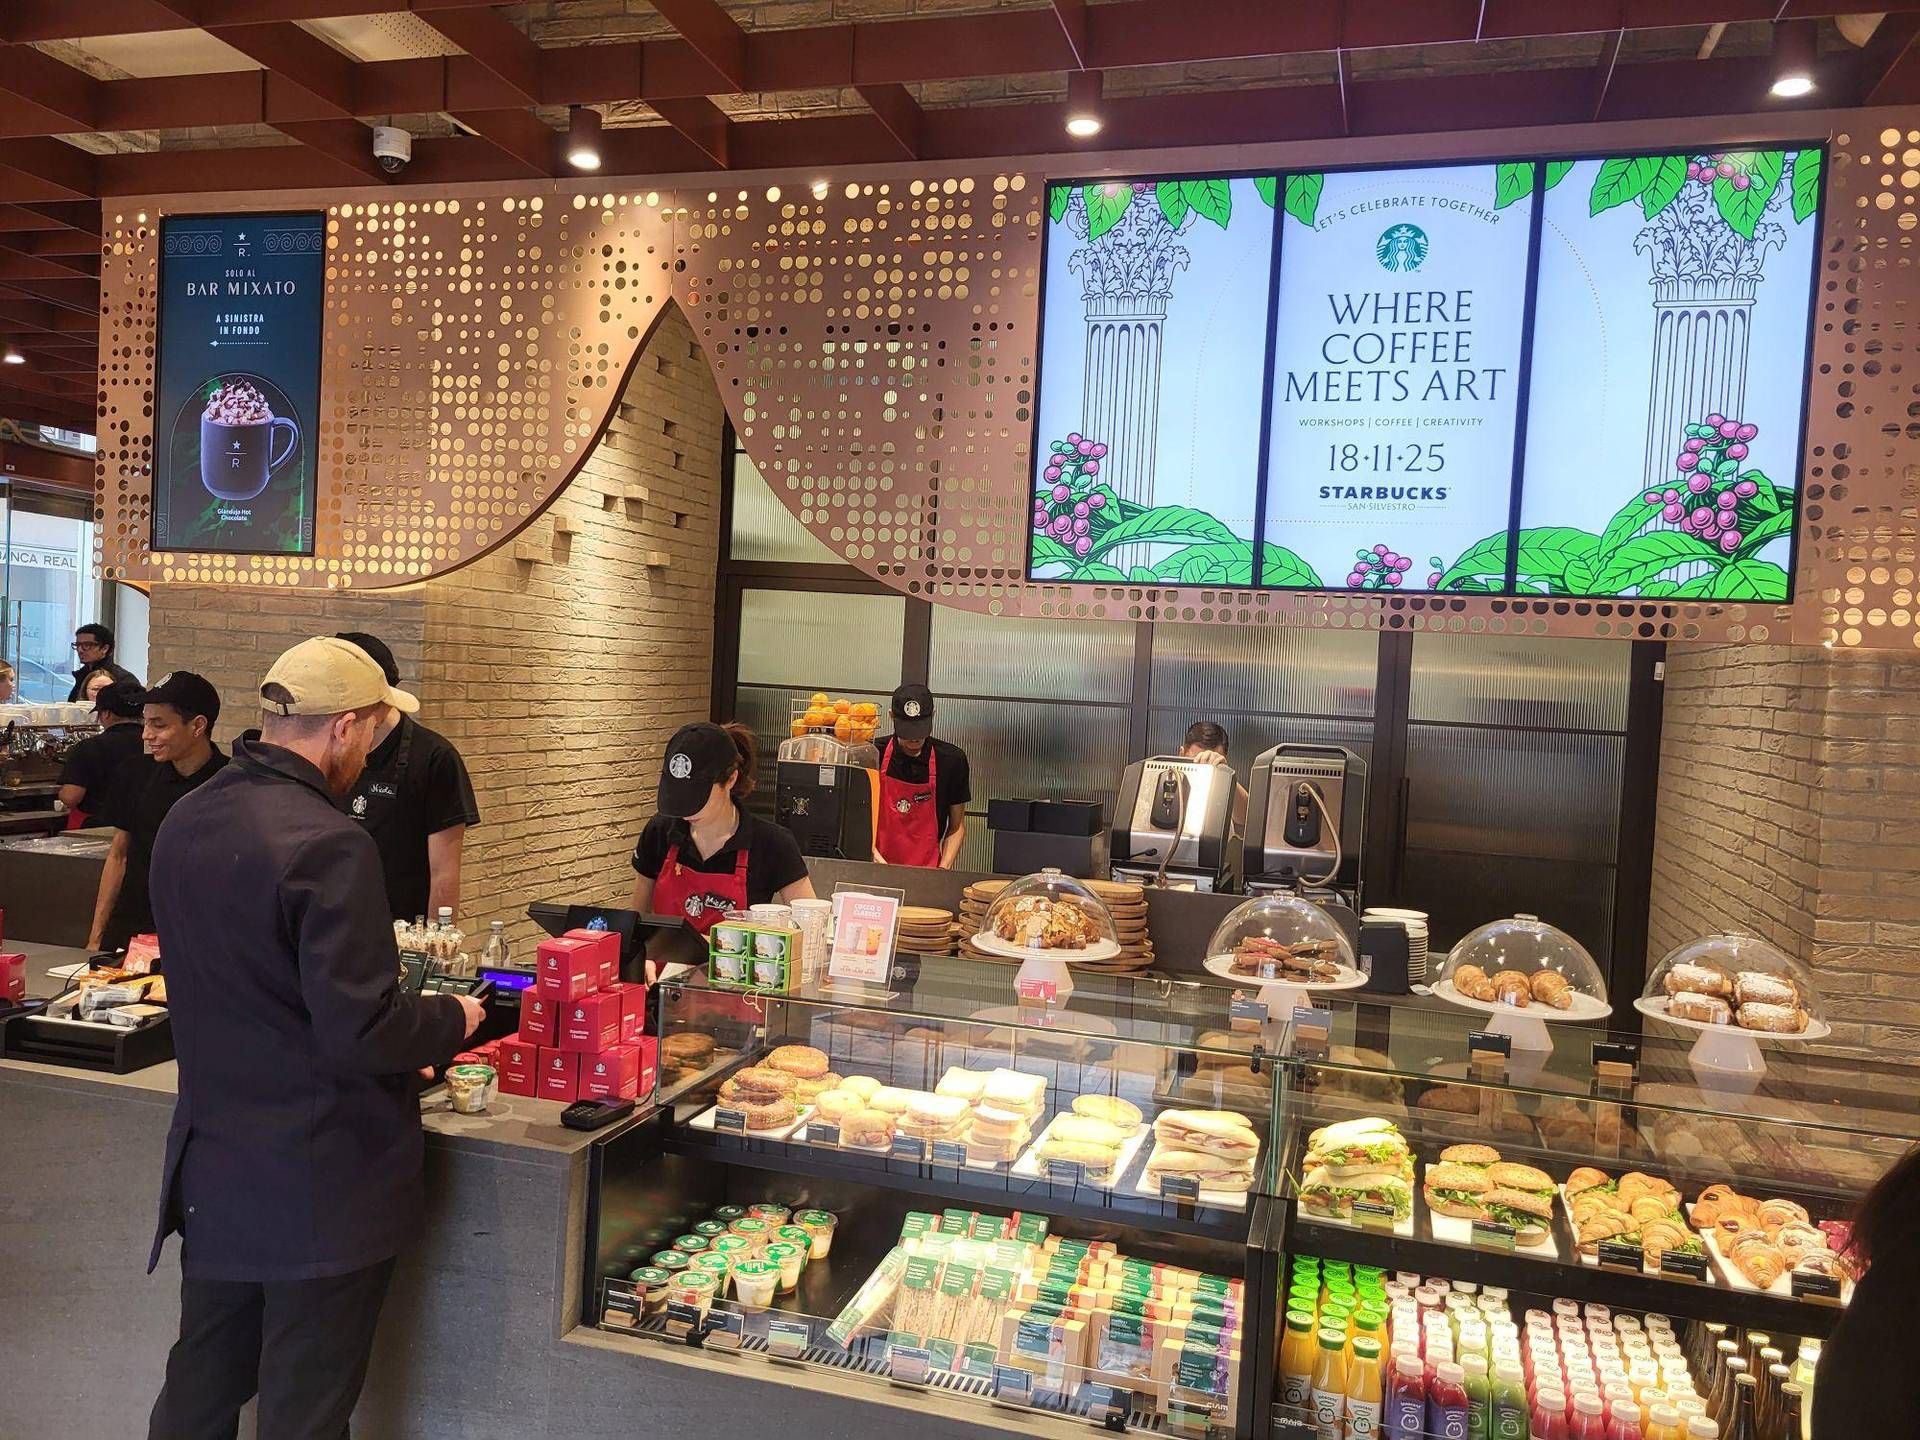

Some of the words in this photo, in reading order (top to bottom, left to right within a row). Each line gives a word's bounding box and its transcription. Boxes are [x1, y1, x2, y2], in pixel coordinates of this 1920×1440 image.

[1313, 211, 1346, 233] LET'S
[1350, 196, 1425, 215] CELEBRATE
[1431, 196, 1501, 225] TOGETHER
[225, 269, 244, 277] SOLO
[247, 269, 256, 277] AL
[187, 282, 218, 296] BAR
[227, 281, 296, 296] MIXATO
[1327, 290, 1473, 325] WHERE
[216, 314, 221, 323] A
[224, 313, 264, 323] SINISTRA
[219, 326, 229, 335] IN
[232, 326, 260, 335] FONDO
[1322, 331, 1472, 365] COFFEE
[1284, 370, 1409, 402] MEETS
[1422, 369, 1506, 401] ART
[1299, 418, 1365, 427] WORKSHOPS
[1374, 418, 1412, 427] COFFEE
[1423, 417, 1483, 427] CREATIVITY
[1319, 485, 1448, 500] STARBUCKS
[1347, 502, 1366, 511] SAN
[1369, 502, 1416, 511] SILVESTRO
[0, 550, 38, 565] ANCA
